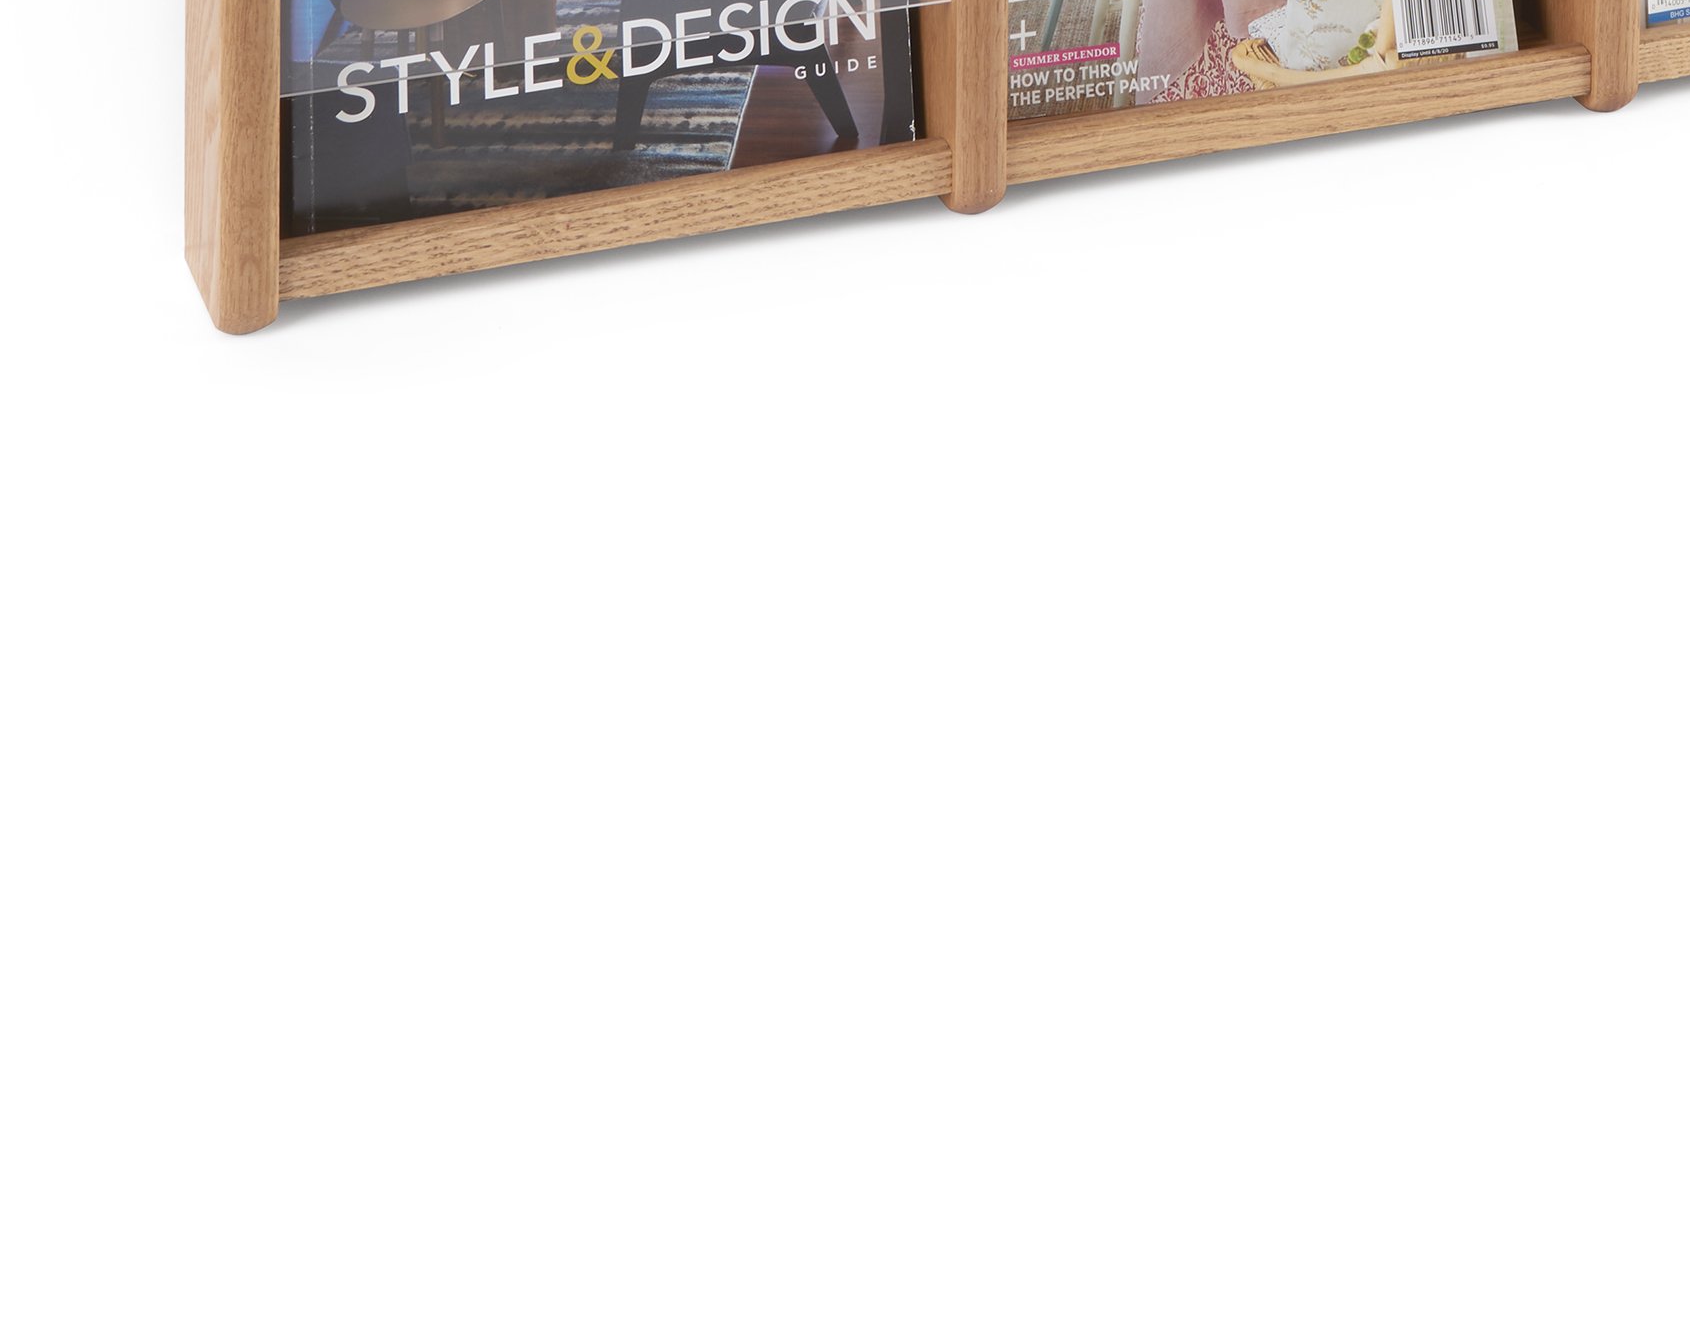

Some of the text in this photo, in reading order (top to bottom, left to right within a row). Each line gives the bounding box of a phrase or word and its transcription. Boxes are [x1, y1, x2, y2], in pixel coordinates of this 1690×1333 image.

[794, 55, 878, 80] GUIDE
[1013, 46, 1117, 68] SUMMER SPLENDOR
[1010, 60, 1139, 90] HOW TO THROW
[1010, 74, 1171, 107] THE PERFECT PARTY
